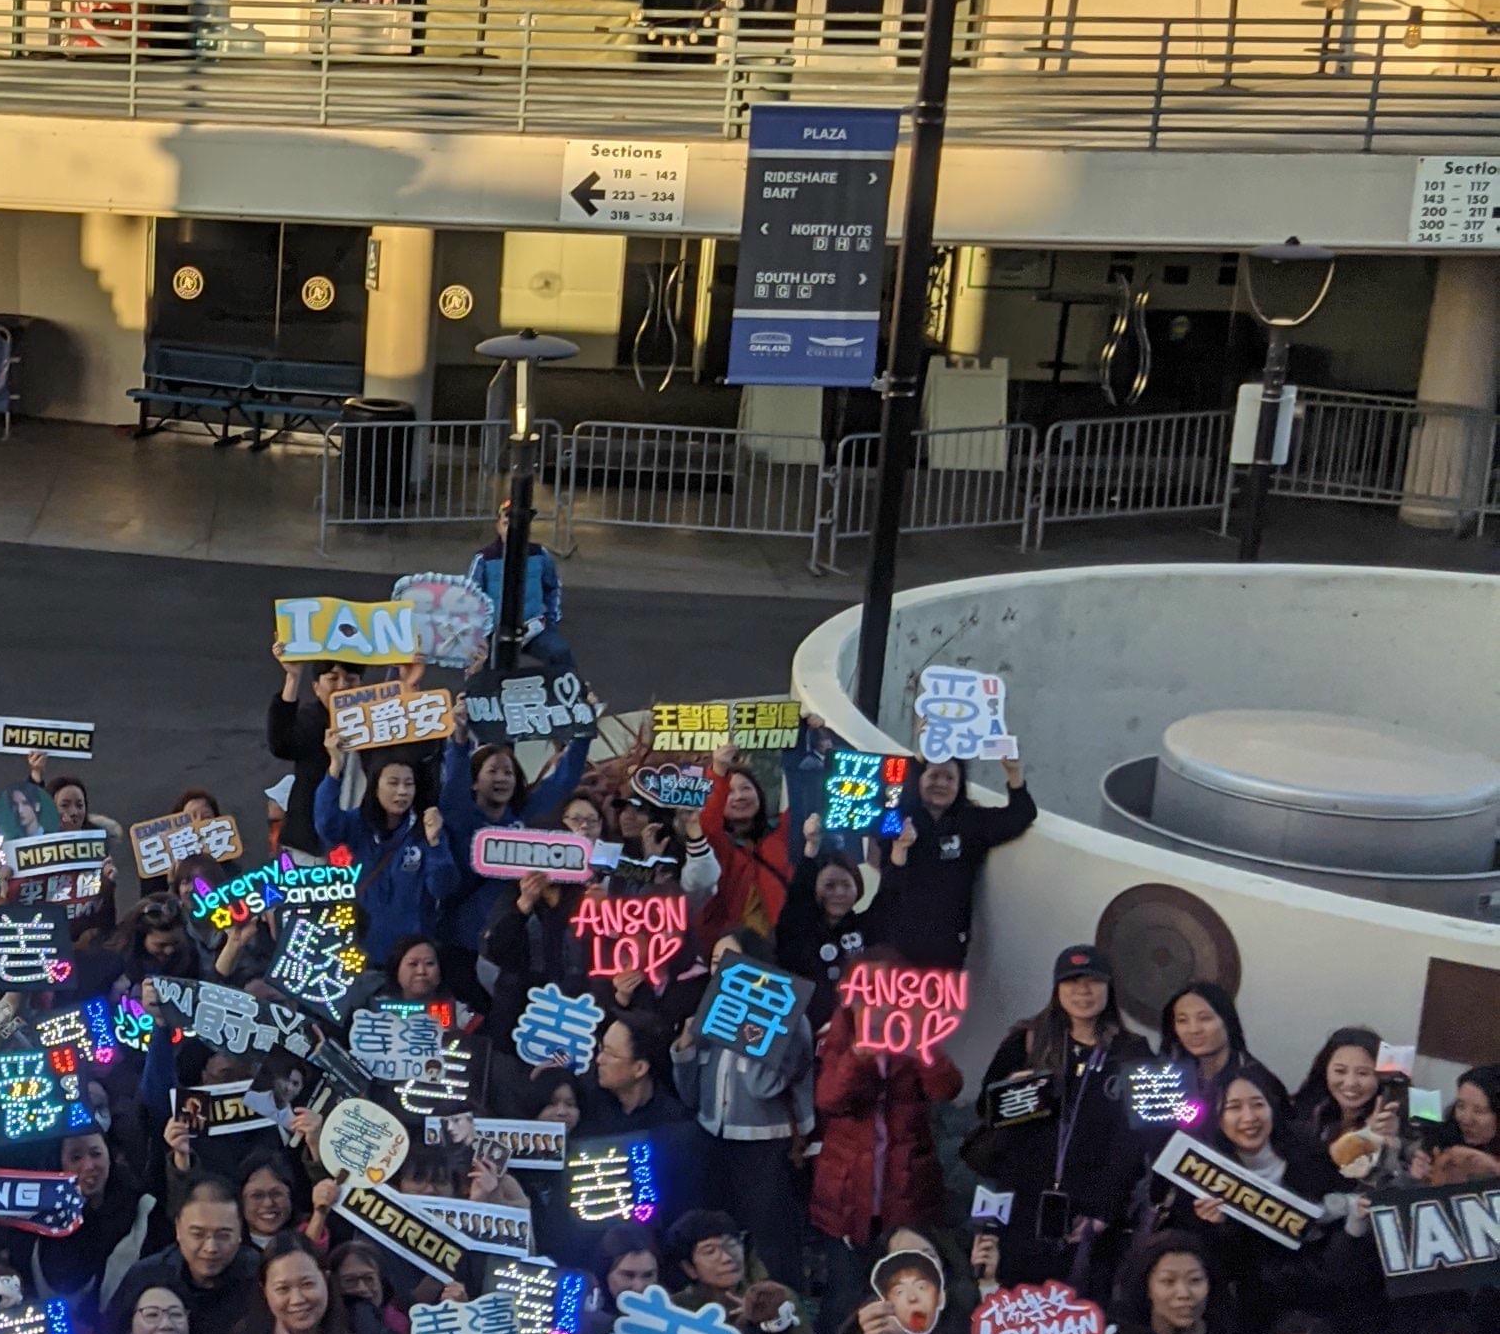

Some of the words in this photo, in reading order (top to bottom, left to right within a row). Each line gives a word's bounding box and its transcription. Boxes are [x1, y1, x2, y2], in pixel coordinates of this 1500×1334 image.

[803, 127, 847, 141] PLAZA
[590, 144, 663, 159] Sections
[613, 169, 632, 179] 118
[656, 170, 677, 181] 142
[1444, 161, 1500, 175] Sectio
[764, 171, 838, 184] RIDESHARE
[763, 187, 798, 199] BART
[1425, 181, 1445, 191] 101
[1470, 181, 1490, 192] 117
[612, 190, 635, 201] 223
[651, 192, 675, 202] 234
[1423, 194, 1444, 204] 143
[1467, 195, 1488, 205] 150
[610, 211, 630, 221] 318
[649, 212, 673, 222] 334
[1421, 207, 1447, 217] 200
[1469, 207, 1487, 217] 211
[791, 224, 837, 236] NORTH
[840, 225, 873, 237] LOTS
[1419, 220, 1445, 230] 300
[1463, 220, 1485, 231] 317
[1418, 233, 1442, 243] 345
[1460, 233, 1484, 243] 355
[755, 272, 799, 284] SOUTH
[803, 272, 836, 285] LOTS
[280, 599, 414, 654] IAN
[335, 694, 448, 749] 呂爵安
[653, 731, 729, 752] ALTON
[734, 727, 800, 750] ALTON
[484, 838, 585, 871] MIRROR
[192, 860, 282, 920] Jeremy
[231, 883, 285, 923] USA
[570, 895, 688, 938] ANSON
[589, 936, 641, 978] LO
[840, 964, 969, 1012] ANSON
[855, 1008, 913, 1055] LO
[1371, 1189, 1500, 1276] IAN
